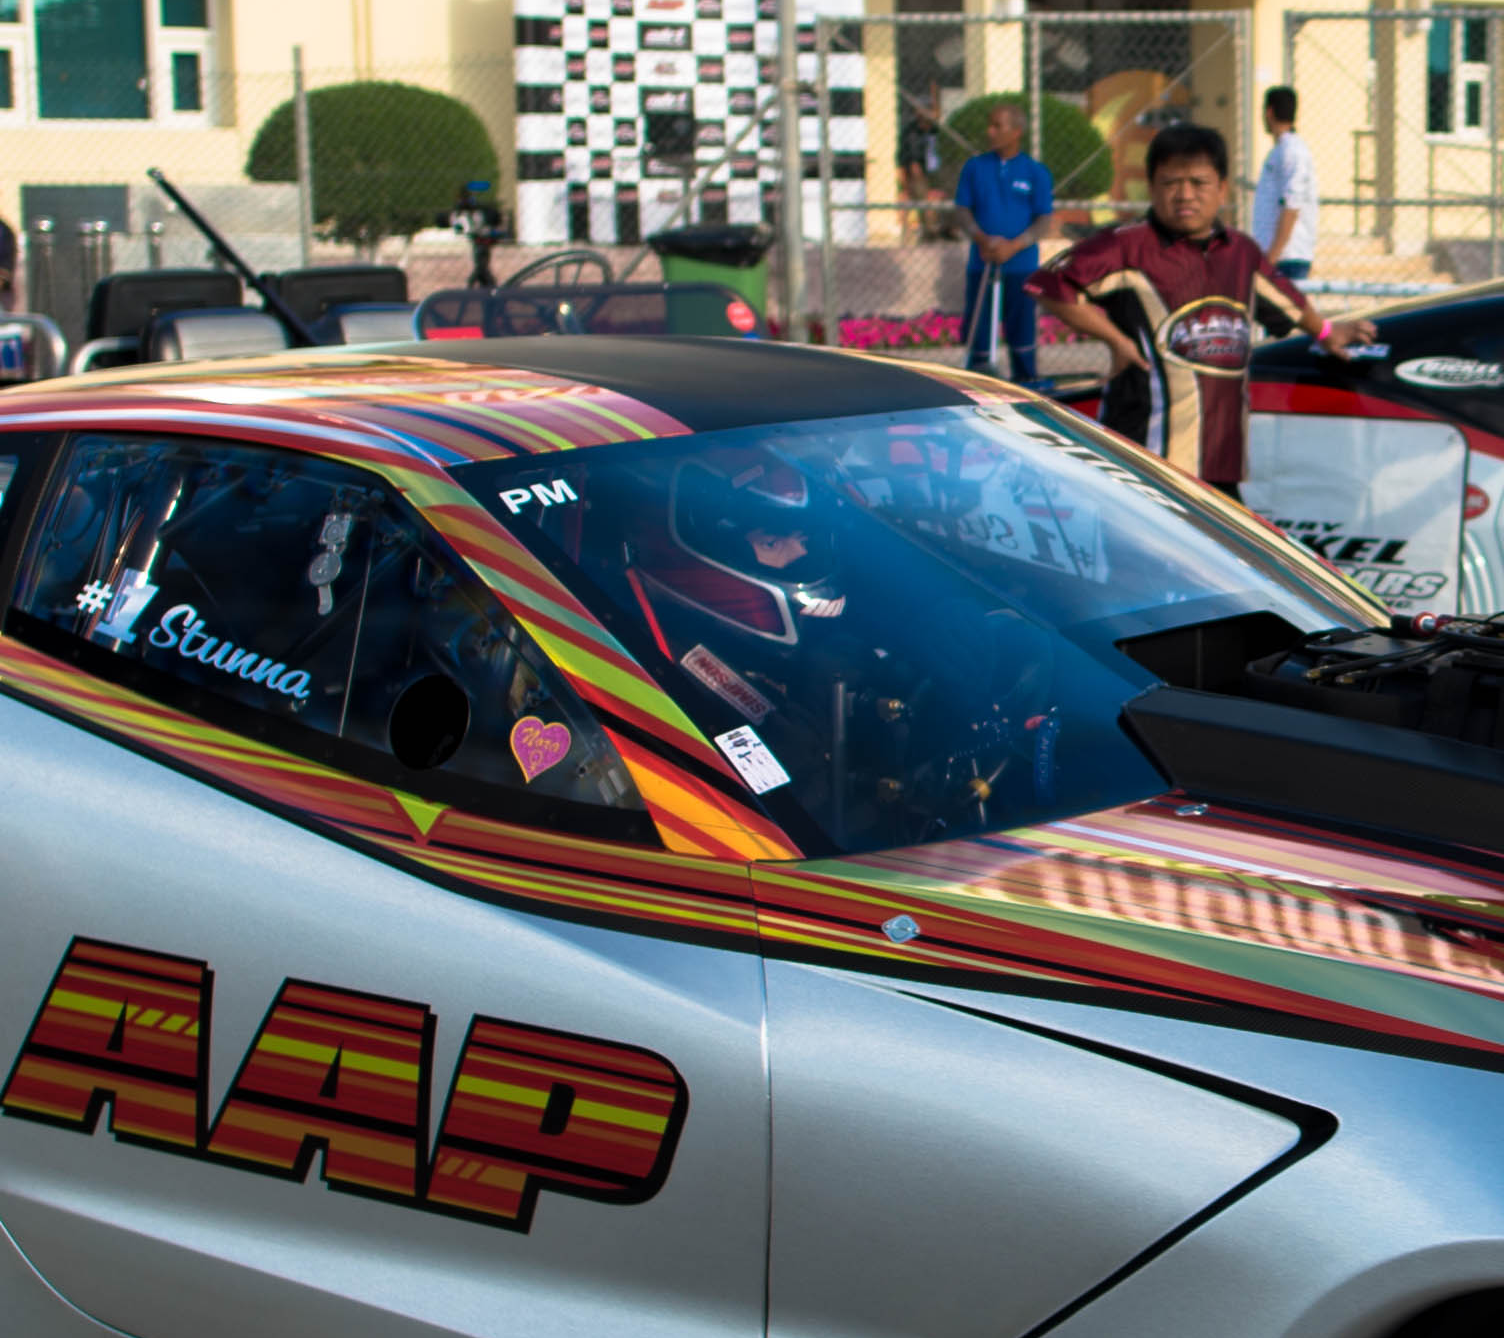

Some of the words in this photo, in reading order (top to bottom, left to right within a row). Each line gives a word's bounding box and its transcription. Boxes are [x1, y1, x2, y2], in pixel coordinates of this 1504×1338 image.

[499, 475, 580, 519] PM
[75, 566, 160, 647] #1
[147, 602, 313, 701] Stunna
